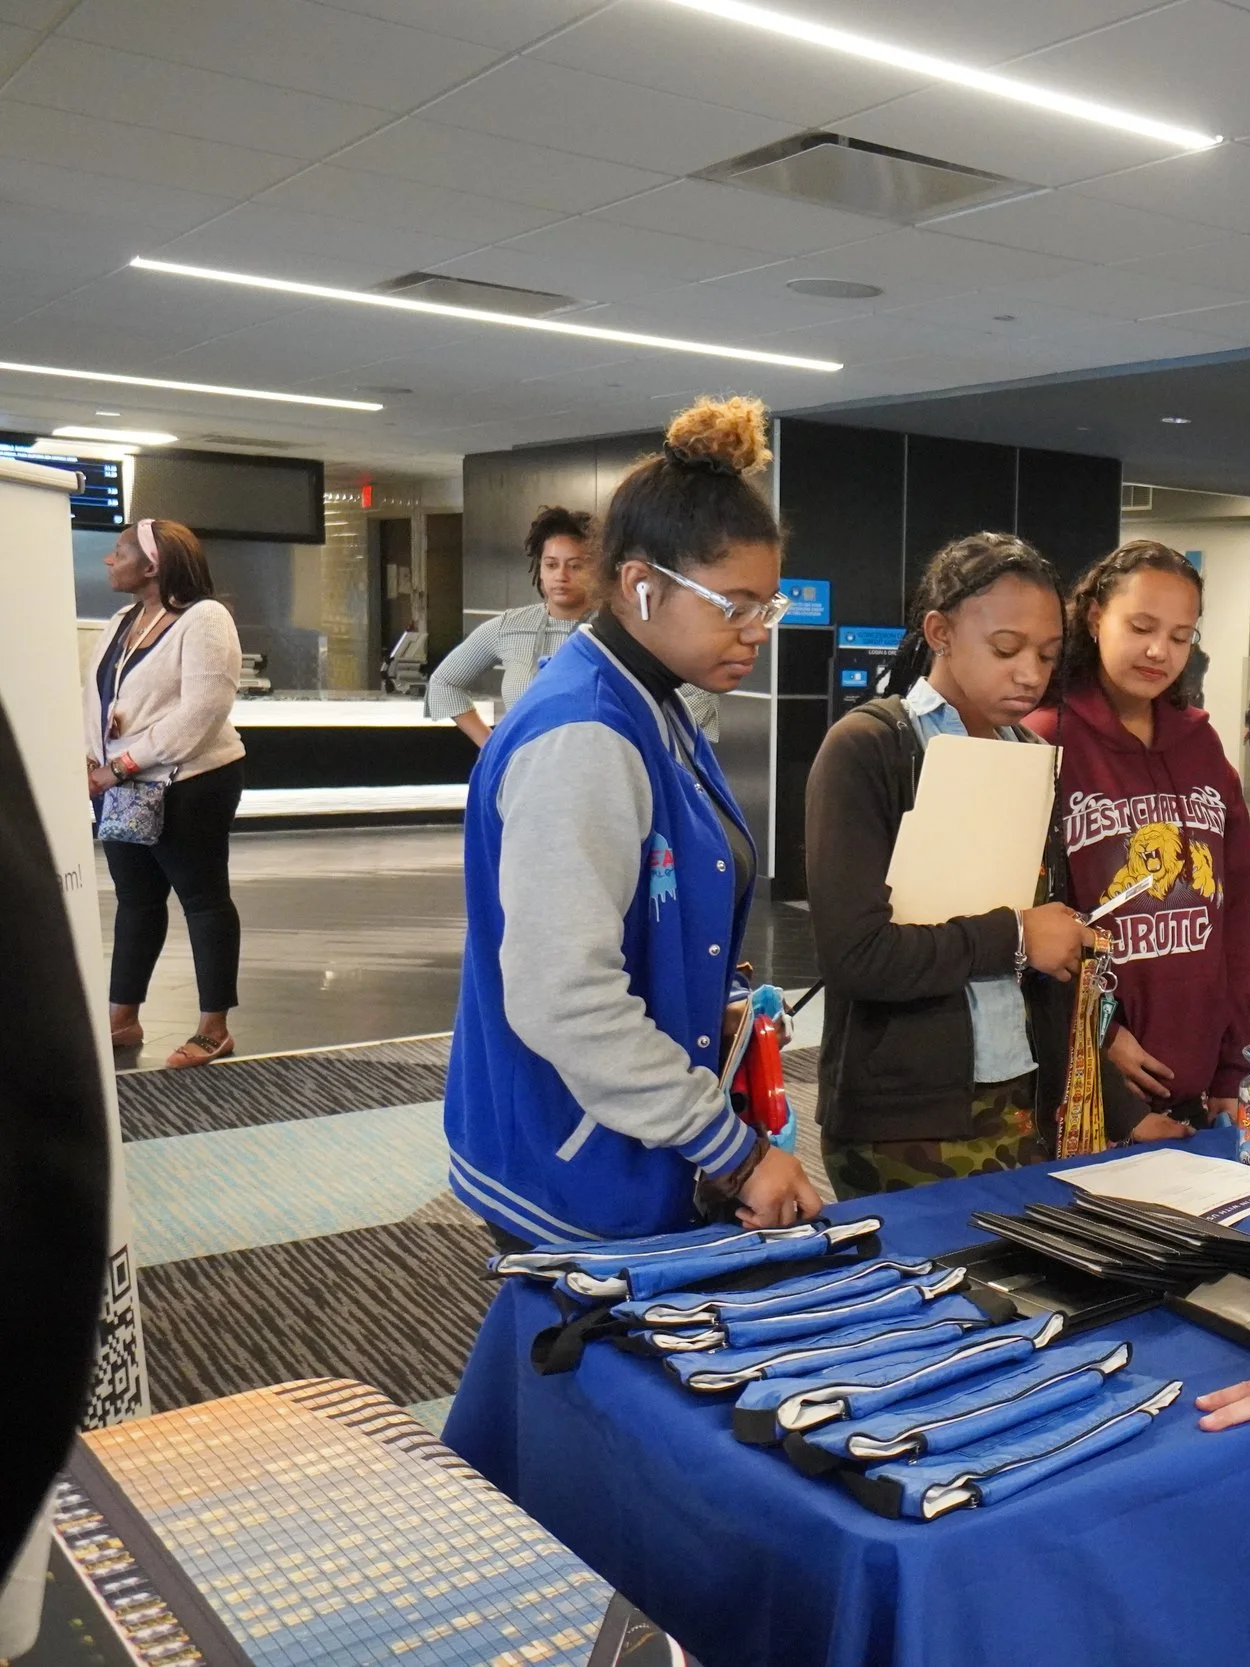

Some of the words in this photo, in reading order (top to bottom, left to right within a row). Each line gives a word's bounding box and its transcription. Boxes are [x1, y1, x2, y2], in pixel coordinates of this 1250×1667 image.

[1063, 797, 1132, 855] WEST
[1111, 906, 1213, 965] JROTC
[1238, 1199, 1250, 1207] IN
[1218, 1204, 1241, 1215] WITH
[1205, 1213, 1219, 1222] US
